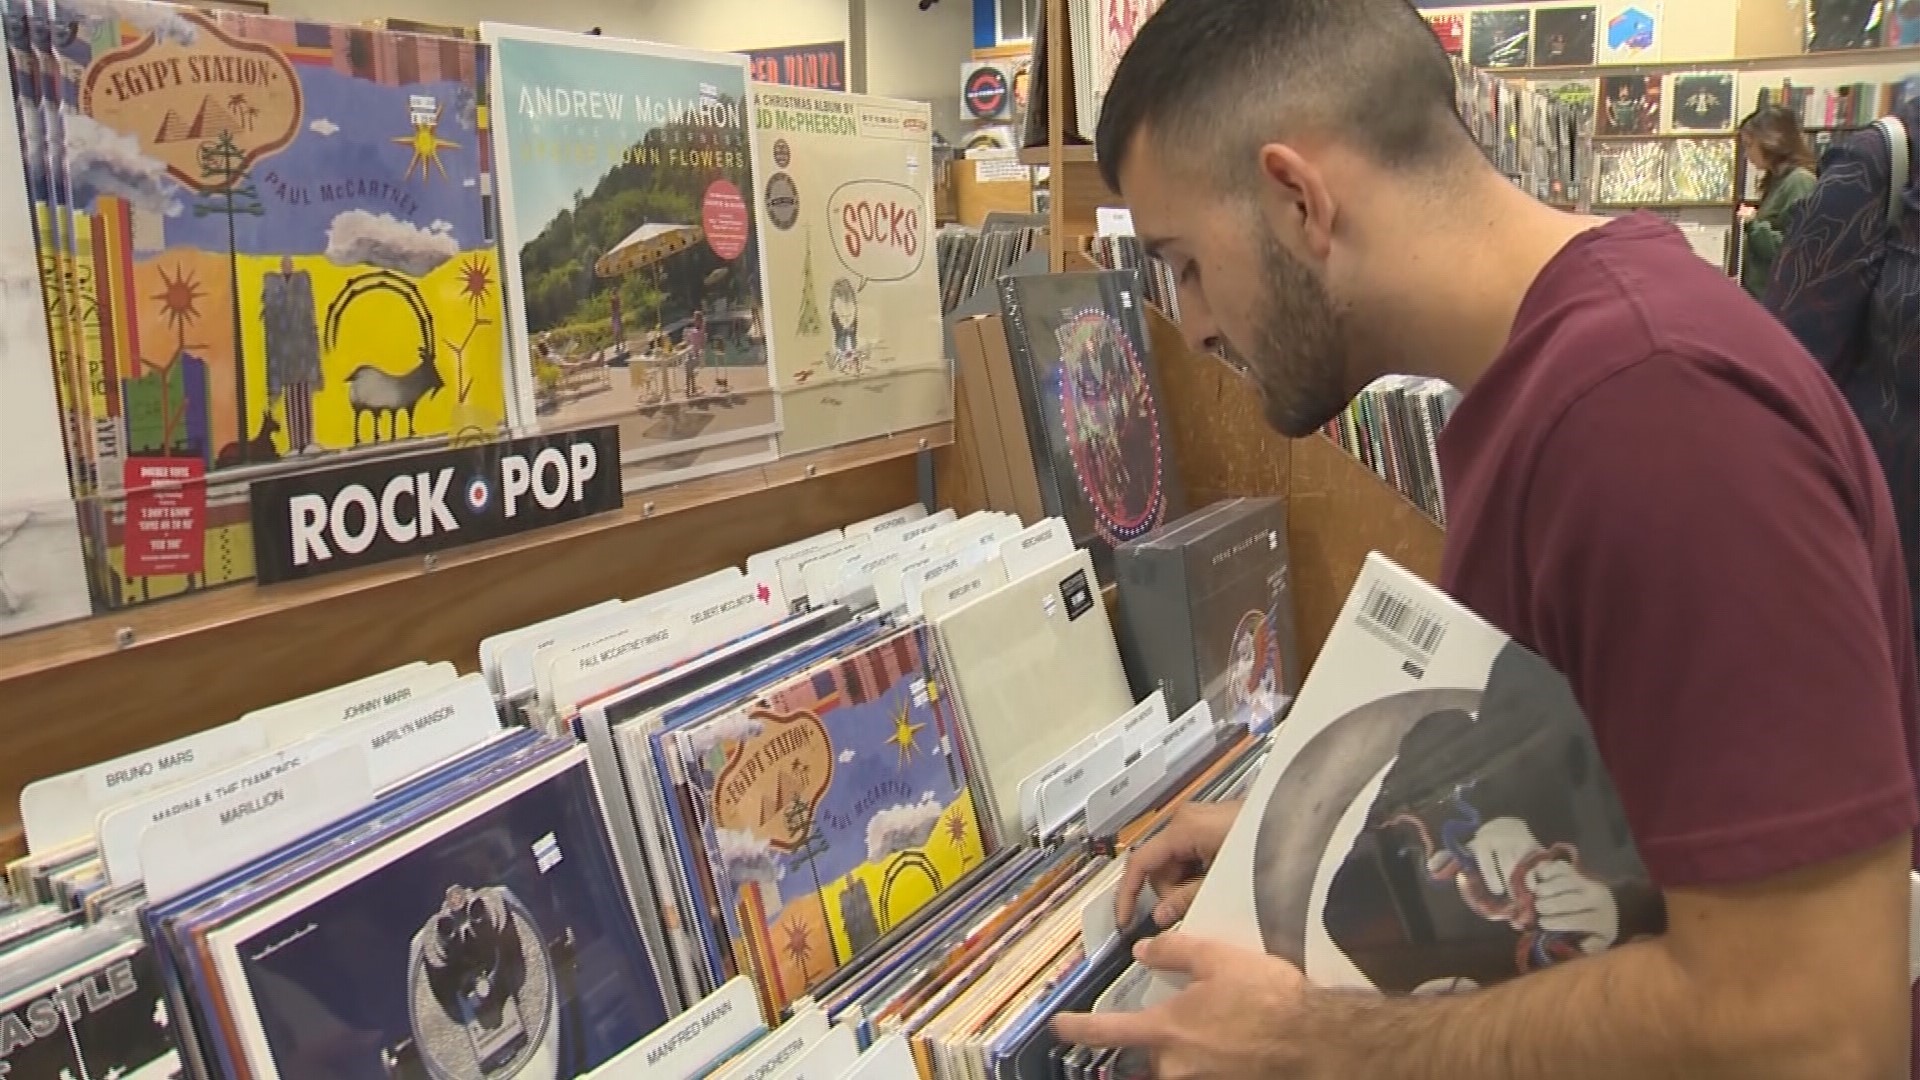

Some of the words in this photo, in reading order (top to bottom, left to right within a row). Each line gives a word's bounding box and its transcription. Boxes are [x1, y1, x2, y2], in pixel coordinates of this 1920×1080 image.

[110, 56, 181, 102] EGYPT
[191, 54, 270, 88] STATION
[784, 53, 841, 88] VINYL
[518, 83, 624, 121] ANDREW
[763, 94, 812, 111] CHRISTMAS
[814, 99, 842, 114] ALBUM
[755, 108, 773, 130] JD
[776, 110, 857, 137] McPHERSON
[670, 149, 744, 169] FLOWERS
[264, 171, 309, 205] PAUL
[842, 200, 918, 258] SOCKS
[289, 466, 461, 567] ROCK
[501, 441, 598, 519] POP
[690, 606, 720, 625] DELBERT
[579, 656, 600, 672] PAUL
[342, 699, 382, 722] JOHNNY
[383, 687, 412, 706] MARR
[371, 721, 415, 751] MARILYN
[415, 704, 455, 731] MANSON
[106, 762, 153, 788] BRUNO
[158, 748, 194, 772] MARS
[727, 756, 765, 806] EGYPT
[764, 721, 811, 766] STATION
[219, 788, 285, 826] MARILLION
[646, 1021, 700, 1067] MANFRED
[701, 999, 733, 1030] MANN
